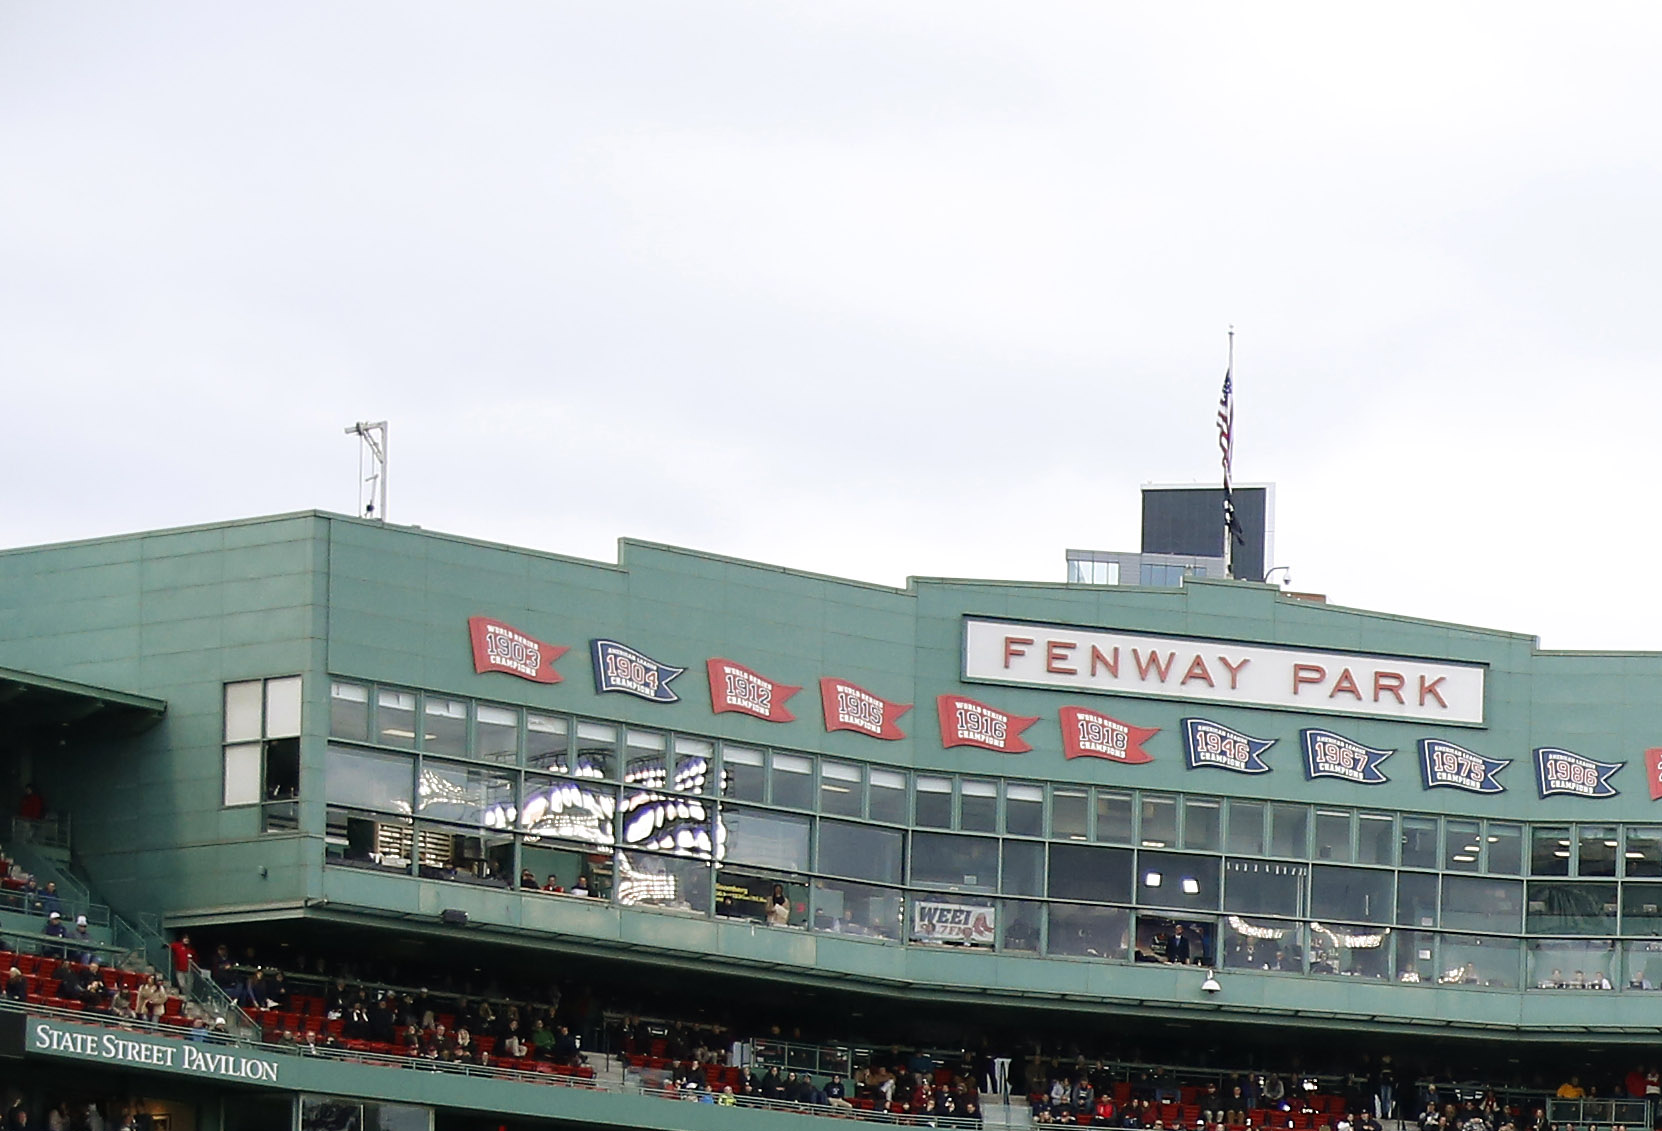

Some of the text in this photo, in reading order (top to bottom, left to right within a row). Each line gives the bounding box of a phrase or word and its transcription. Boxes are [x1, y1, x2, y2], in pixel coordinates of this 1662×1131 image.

[486, 625, 539, 650] WORLD SERIES
[486, 634, 541, 669] 1903
[490, 656, 537, 677] CHAMPIONS
[607, 655, 658, 690] 1904
[723, 666, 772, 690] WORLD SERIES
[1003, 636, 1449, 709] FENWAY PARK
[611, 677, 655, 697] CHAMPIONS
[725, 675, 772, 708] 1912
[836, 685, 883, 708] WORLD SERIES
[726, 696, 770, 716] CHAMPIONS
[838, 693, 883, 726] 1915
[955, 702, 1008, 722] WORLD SERIES
[839, 714, 881, 733] CHAMPIONS
[956, 711, 1007, 740] 1916
[1076, 713, 1128, 733] WORLD SERIES
[958, 730, 1005, 748] CHAMPIONS
[1078, 721, 1128, 750] 1918
[1197, 732, 1249, 762] 1946
[1079, 741, 1126, 758] CHAMPIONS
[1200, 752, 1246, 769] CHAMPIONS
[1315, 742, 1368, 771] 1967
[1319, 762, 1364, 779] CHAMPIONS
[1433, 752, 1486, 782] 1975
[1547, 760, 1598, 787] 1986
[1436, 772, 1481, 789] CHAMPIONS
[1550, 780, 1594, 794] CHAMPIONS
[920, 906, 973, 925] WEEI
[36, 1024, 278, 1082] STATE STREET PAVILION
